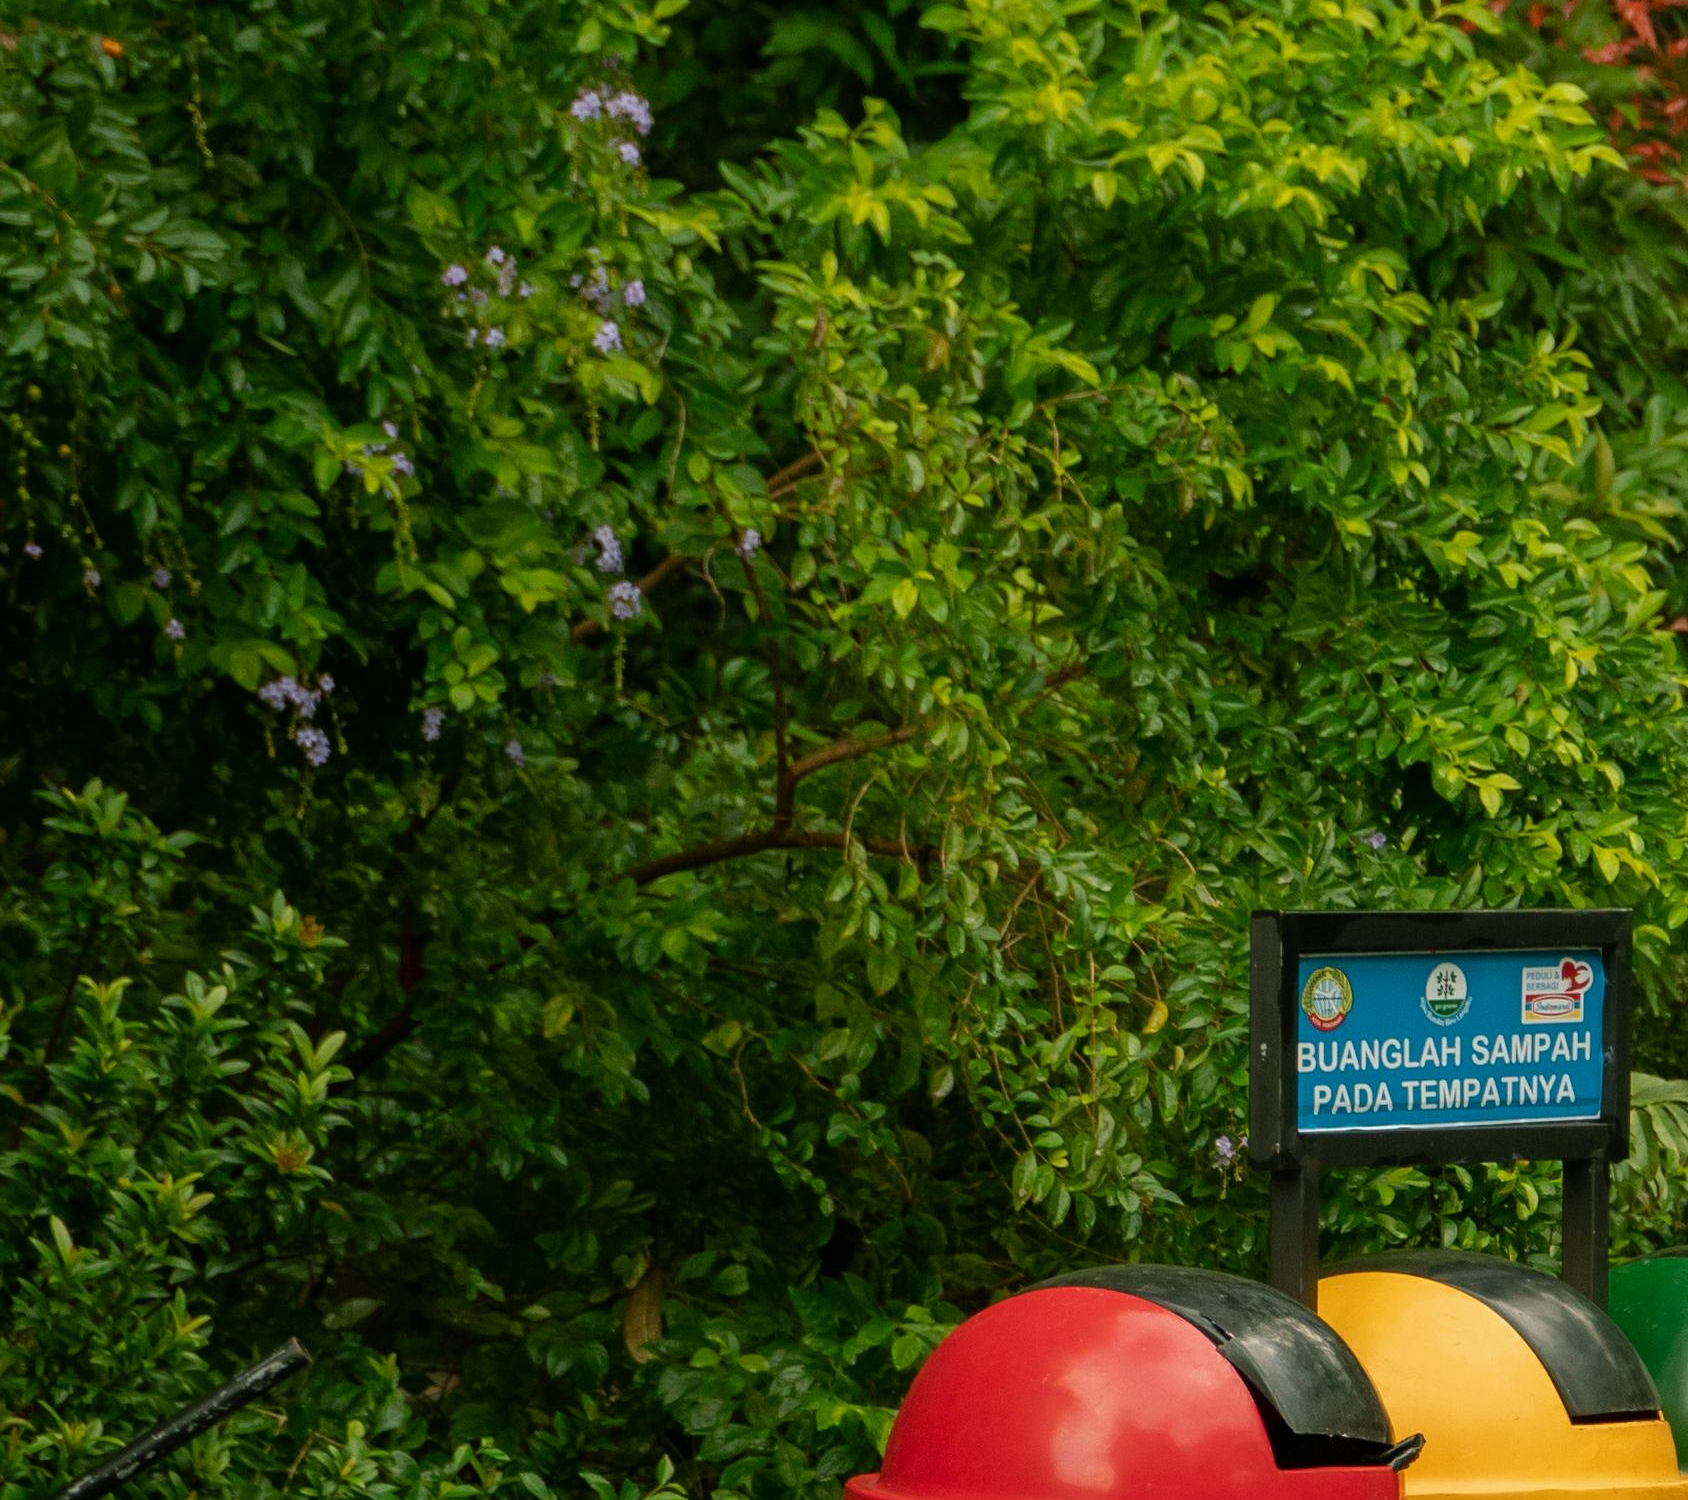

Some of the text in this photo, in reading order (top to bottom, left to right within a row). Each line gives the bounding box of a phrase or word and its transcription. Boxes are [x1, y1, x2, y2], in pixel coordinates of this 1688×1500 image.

[1297, 1031, 1591, 1073] BUANGLAH SAMPAH
[1313, 1073, 1576, 1115] PADA TEMPATNYA
